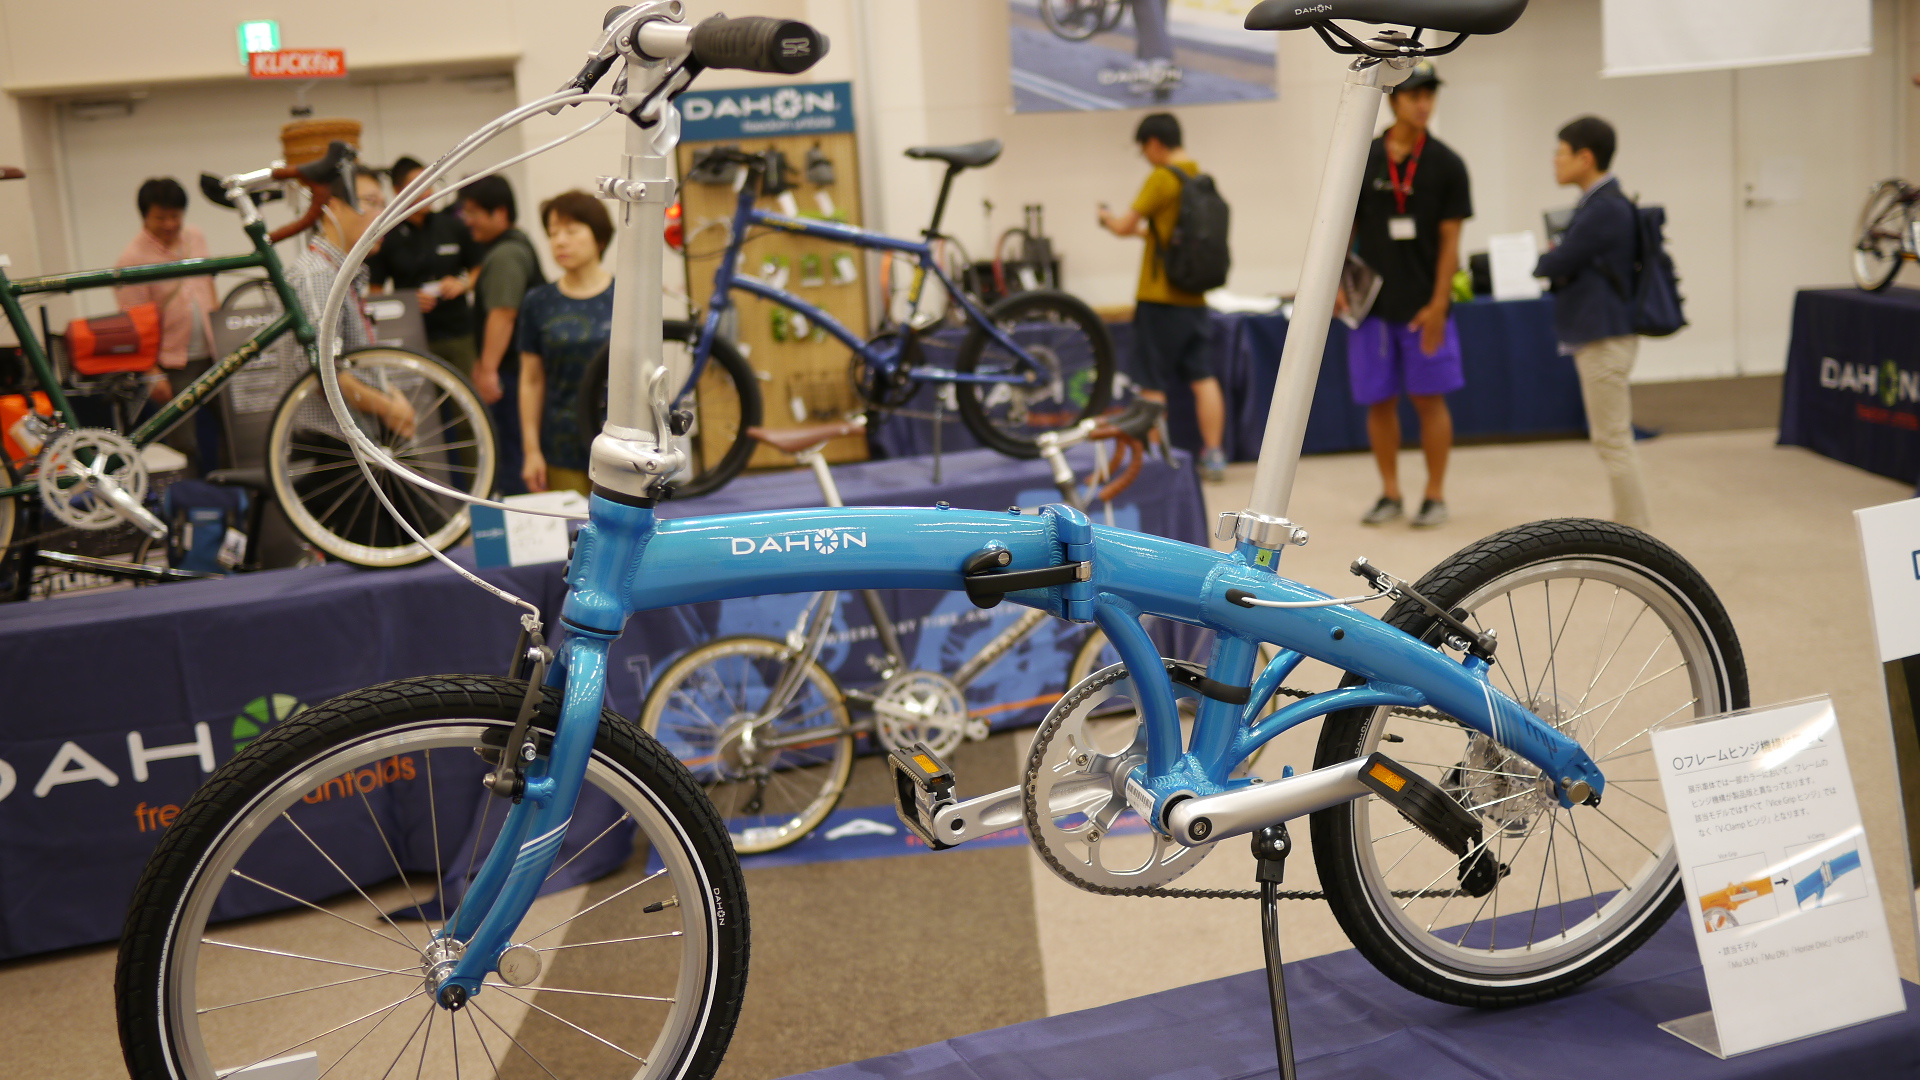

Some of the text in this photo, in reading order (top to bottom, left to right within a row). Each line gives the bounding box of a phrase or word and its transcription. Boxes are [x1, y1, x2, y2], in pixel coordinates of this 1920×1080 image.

[1294, 4, 1332, 16] DAHON
[682, 87, 835, 121] DAHON
[175, 338, 260, 412] DAHON
[1821, 356, 1920, 406] DAHON
[731, 528, 867, 555] DAHON
[713, 887, 726, 926] DAHON
